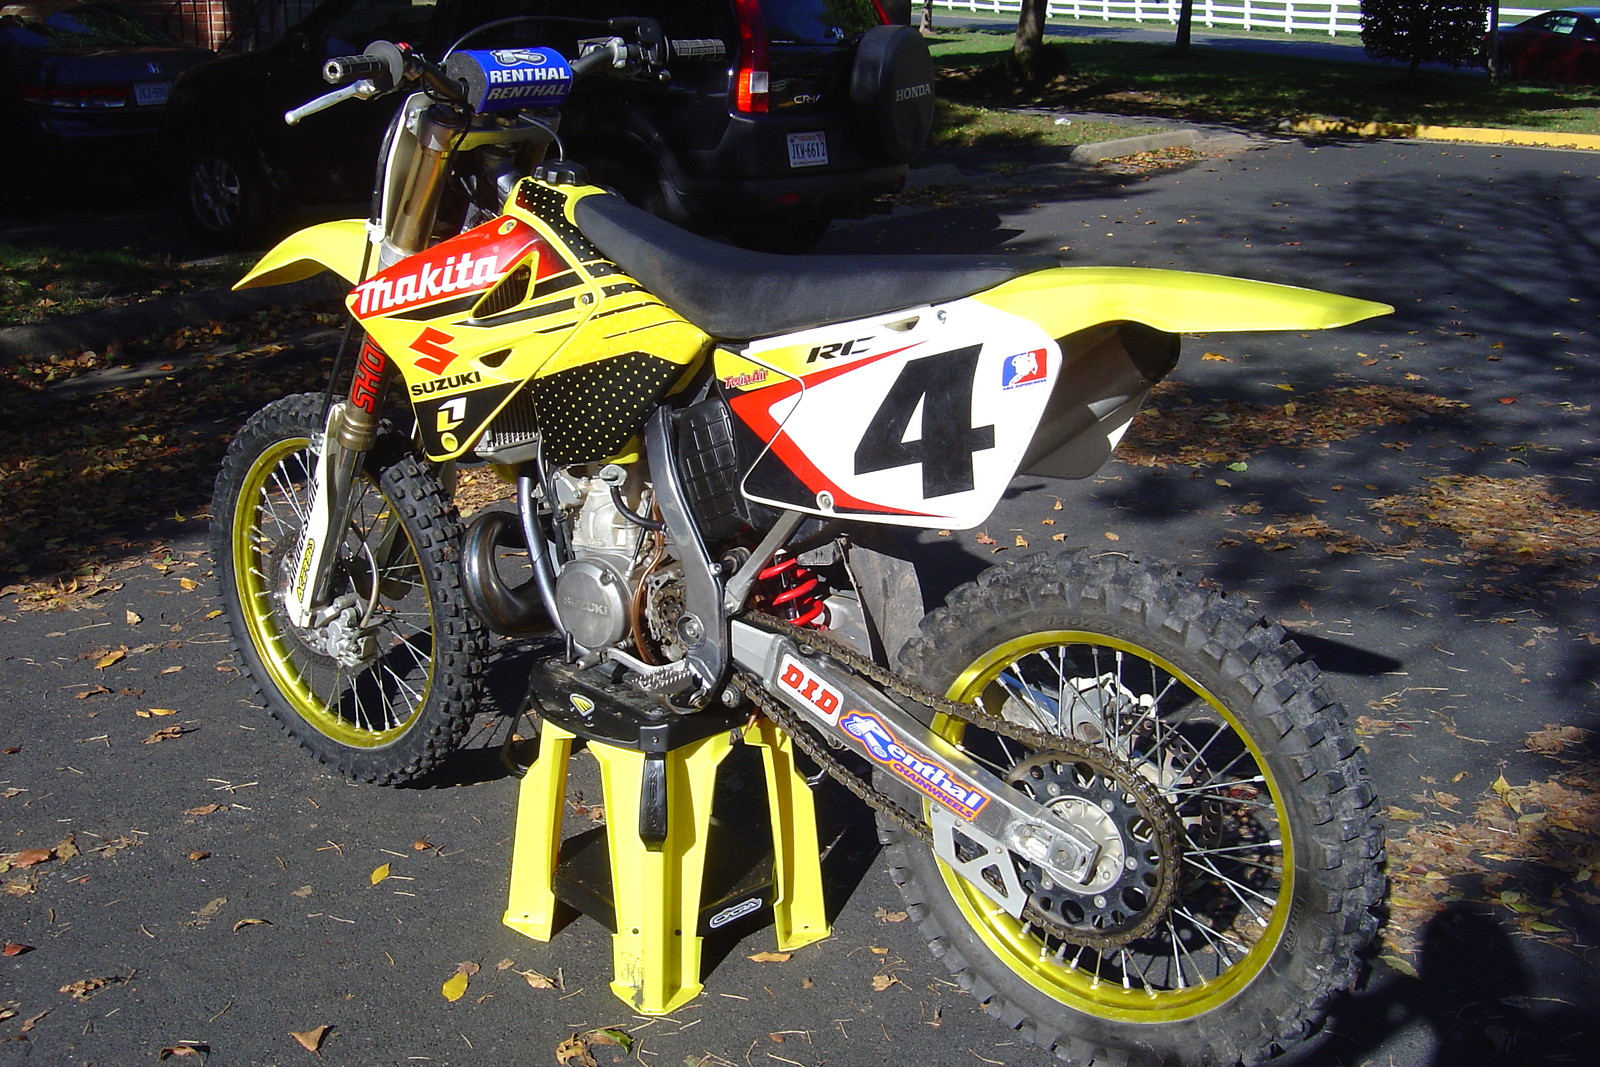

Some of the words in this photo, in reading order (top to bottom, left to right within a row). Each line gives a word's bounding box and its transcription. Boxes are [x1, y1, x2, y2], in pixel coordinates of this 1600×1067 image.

[489, 67, 570, 84] RENTHAL
[486, 84, 566, 101] RENTHAL
[896, 83, 932, 102] HONDA
[355, 252, 509, 316] makita
[806, 336, 876, 364] RC
[351, 333, 387, 414] SHO
[411, 371, 482, 397] SUZUKI
[723, 373, 751, 390] Twin
[751, 368, 770, 384] Air
[854, 342, 996, 500] 4
[892, 762, 974, 819] CHAINWHEELS
[711, 899, 761, 926] CYCRA
